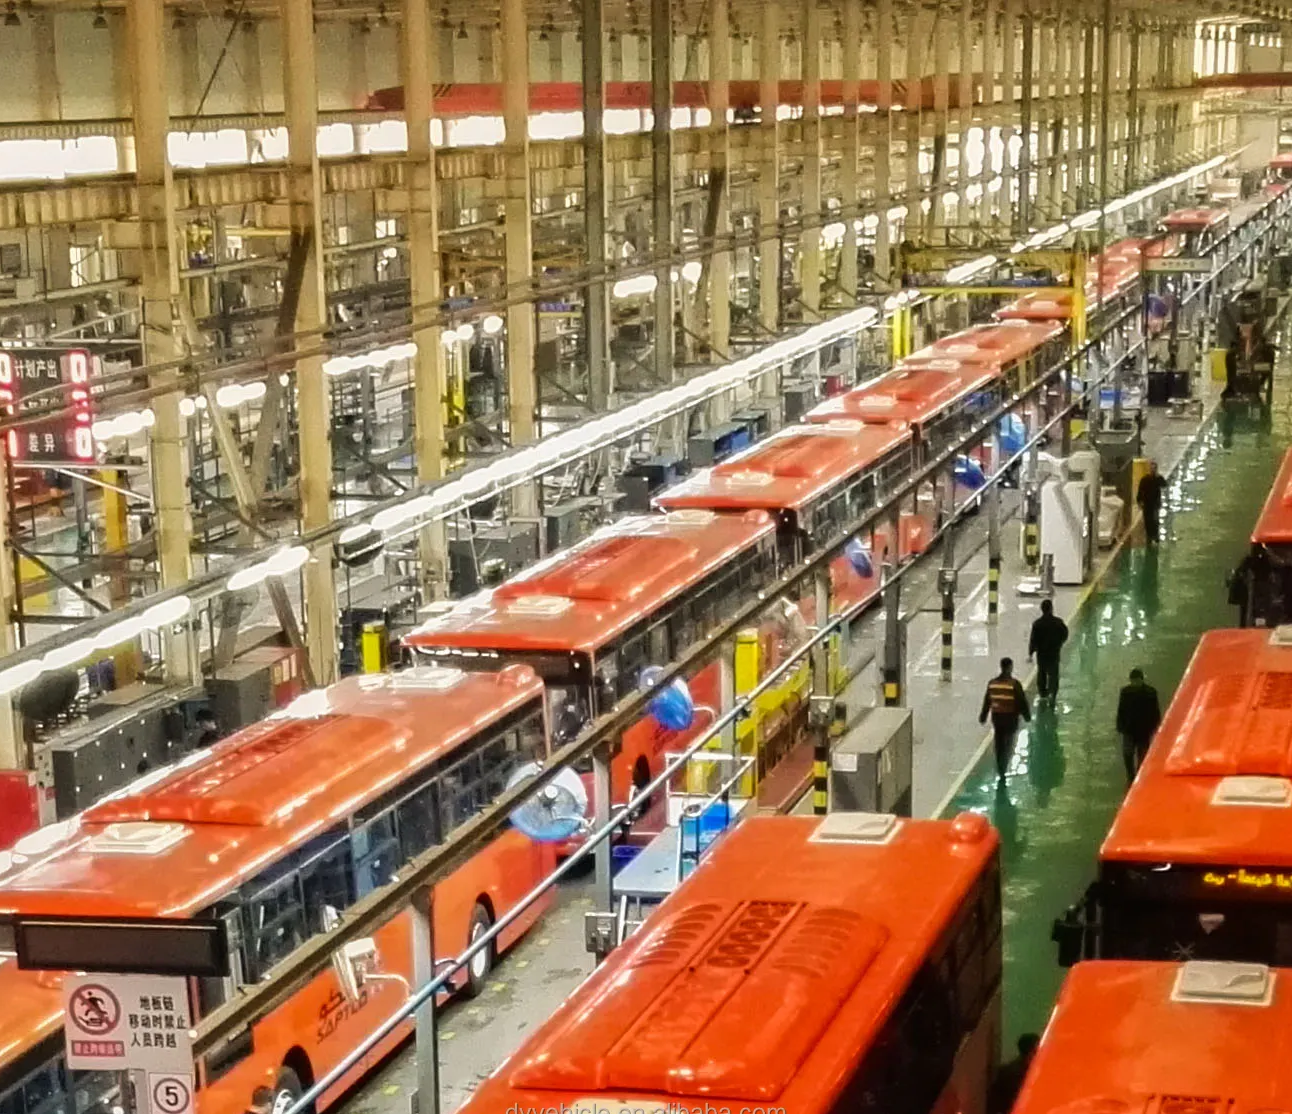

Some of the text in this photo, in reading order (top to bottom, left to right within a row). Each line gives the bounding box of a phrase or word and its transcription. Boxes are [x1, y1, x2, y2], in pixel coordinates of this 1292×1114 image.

[139, 996, 174, 1011] 地板链
[129, 1014, 187, 1029] 移动时禁止
[131, 1034, 177, 1048] 人员跨越
[165, 1086, 178, 1106] 5
